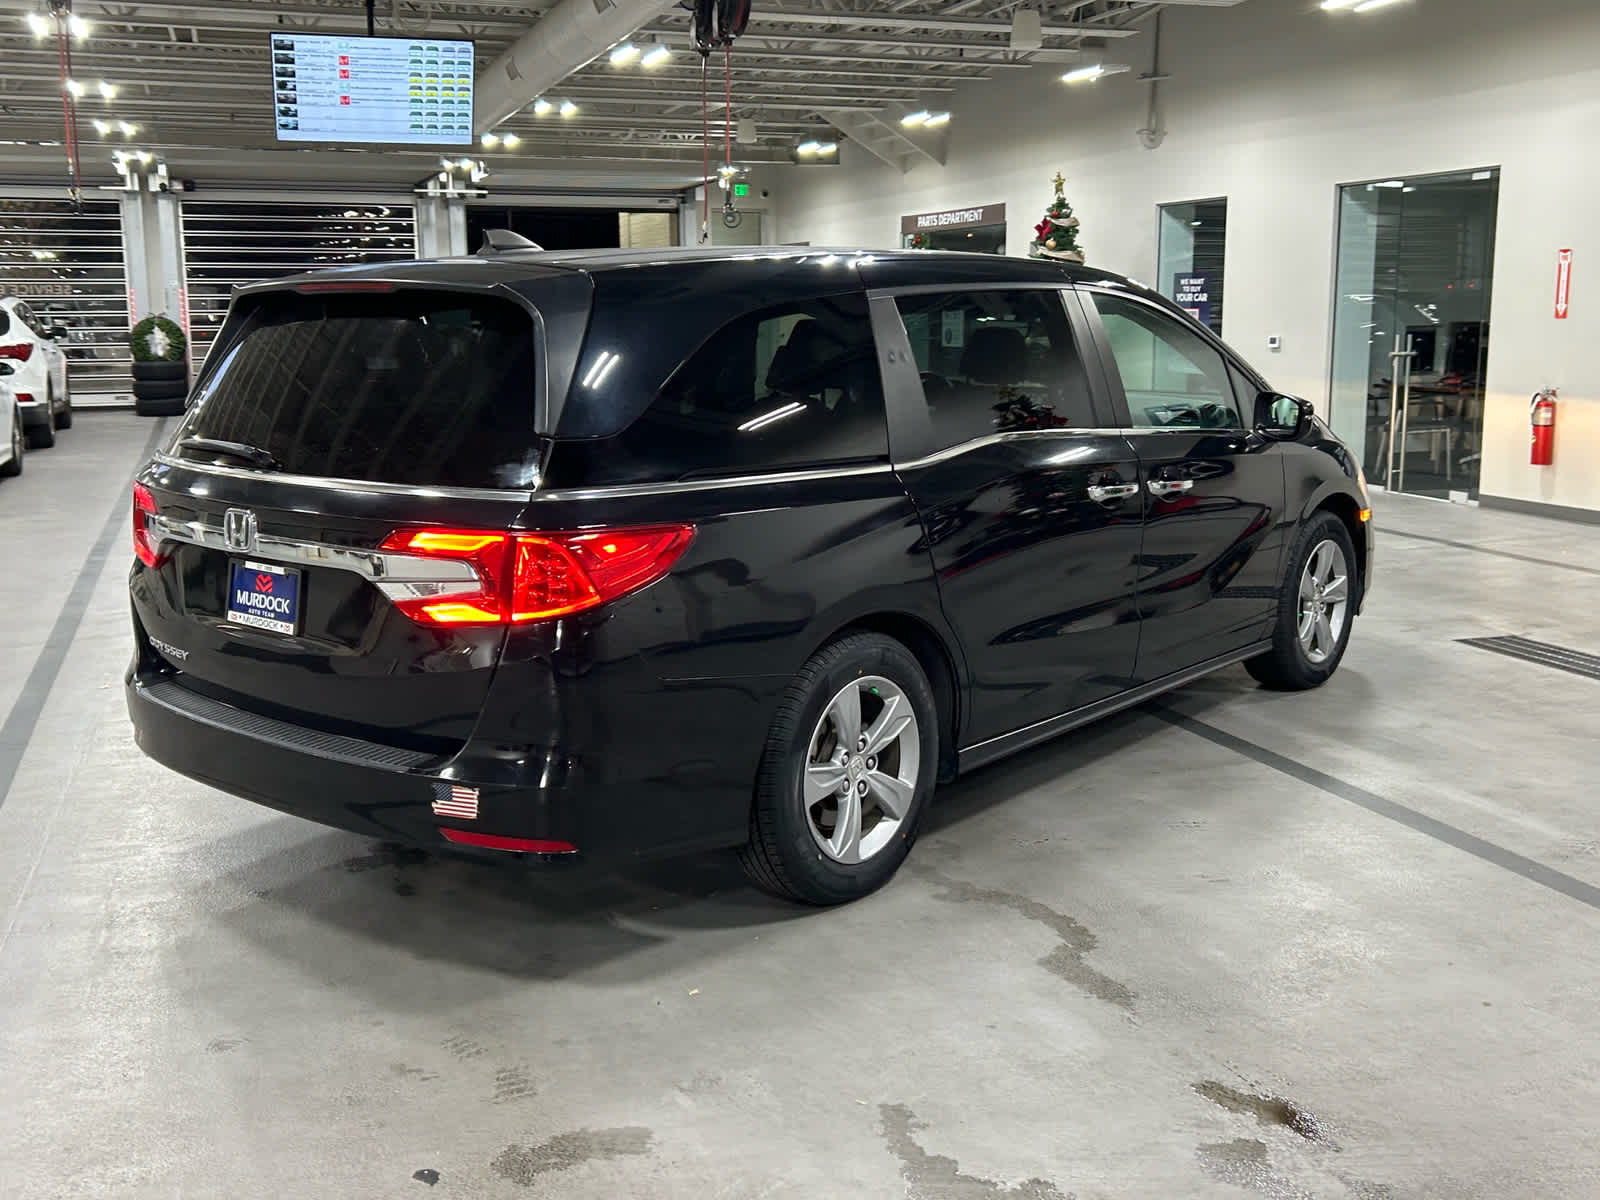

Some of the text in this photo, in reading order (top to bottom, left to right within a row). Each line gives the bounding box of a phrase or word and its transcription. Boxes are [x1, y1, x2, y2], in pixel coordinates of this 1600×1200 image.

[917, 209, 984, 227] PARTS DEPARTMENT
[1176, 293, 1208, 302] YOUR CAR
[236, 589, 290, 614] MURDOCK
[243, 615, 279, 630] MURDOCK
[149, 636, 189, 661] ODYSSEY
